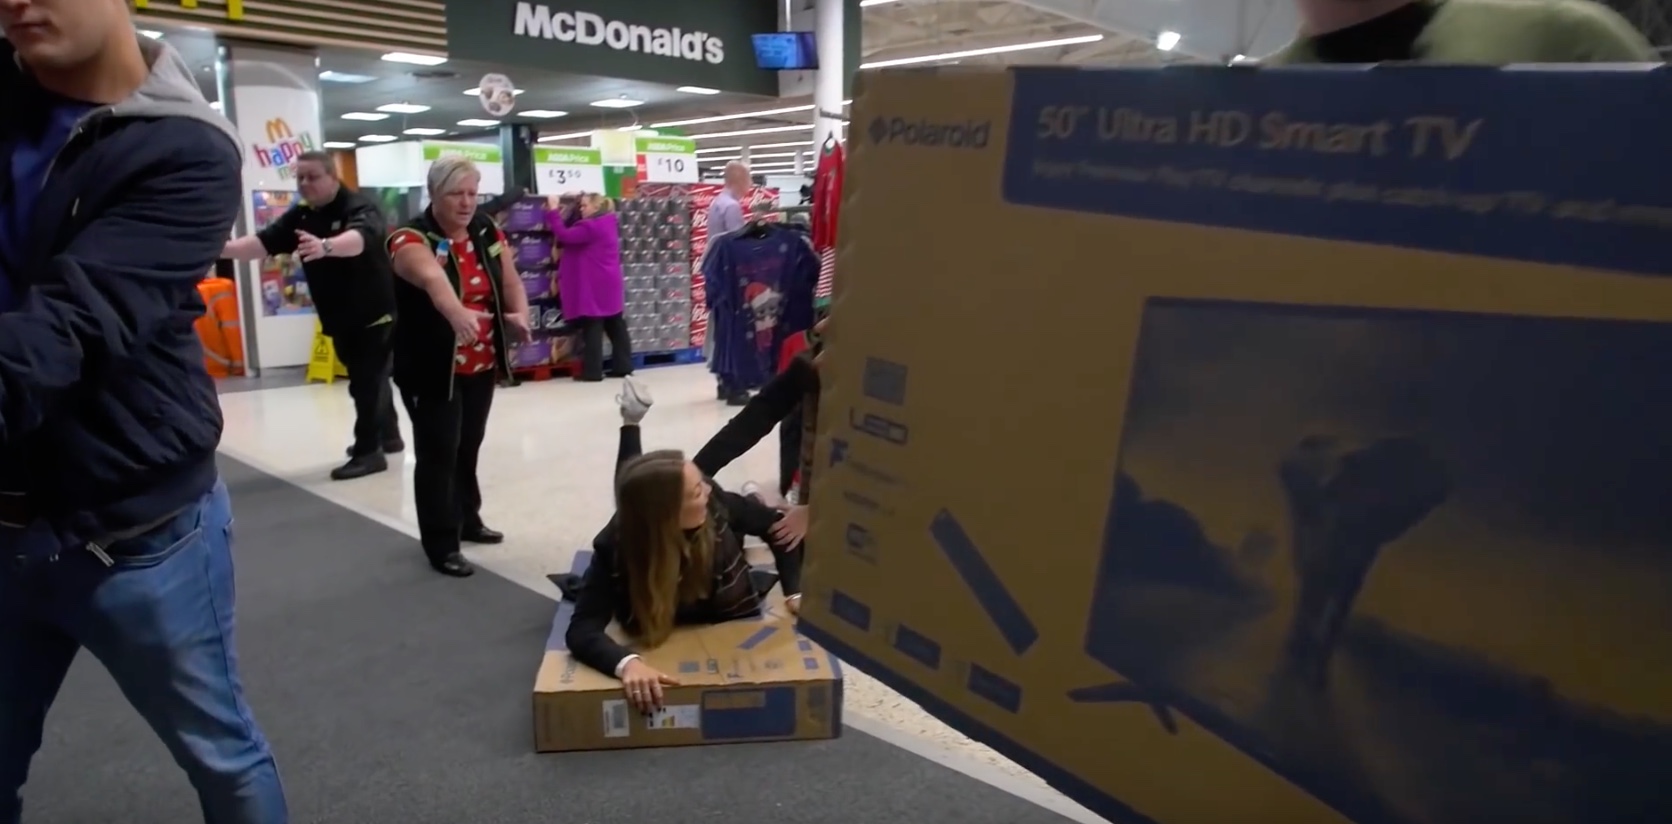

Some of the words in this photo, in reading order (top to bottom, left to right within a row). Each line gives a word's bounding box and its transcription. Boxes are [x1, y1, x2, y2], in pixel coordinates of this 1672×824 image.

[514, 2, 724, 64] McDonald's
[889, 116, 991, 150] Polaroid
[1096, 105, 1177, 143] Ultra
[1187, 109, 1251, 147] HD
[1258, 111, 1392, 157] Smart
[1404, 115, 1485, 160] TV
